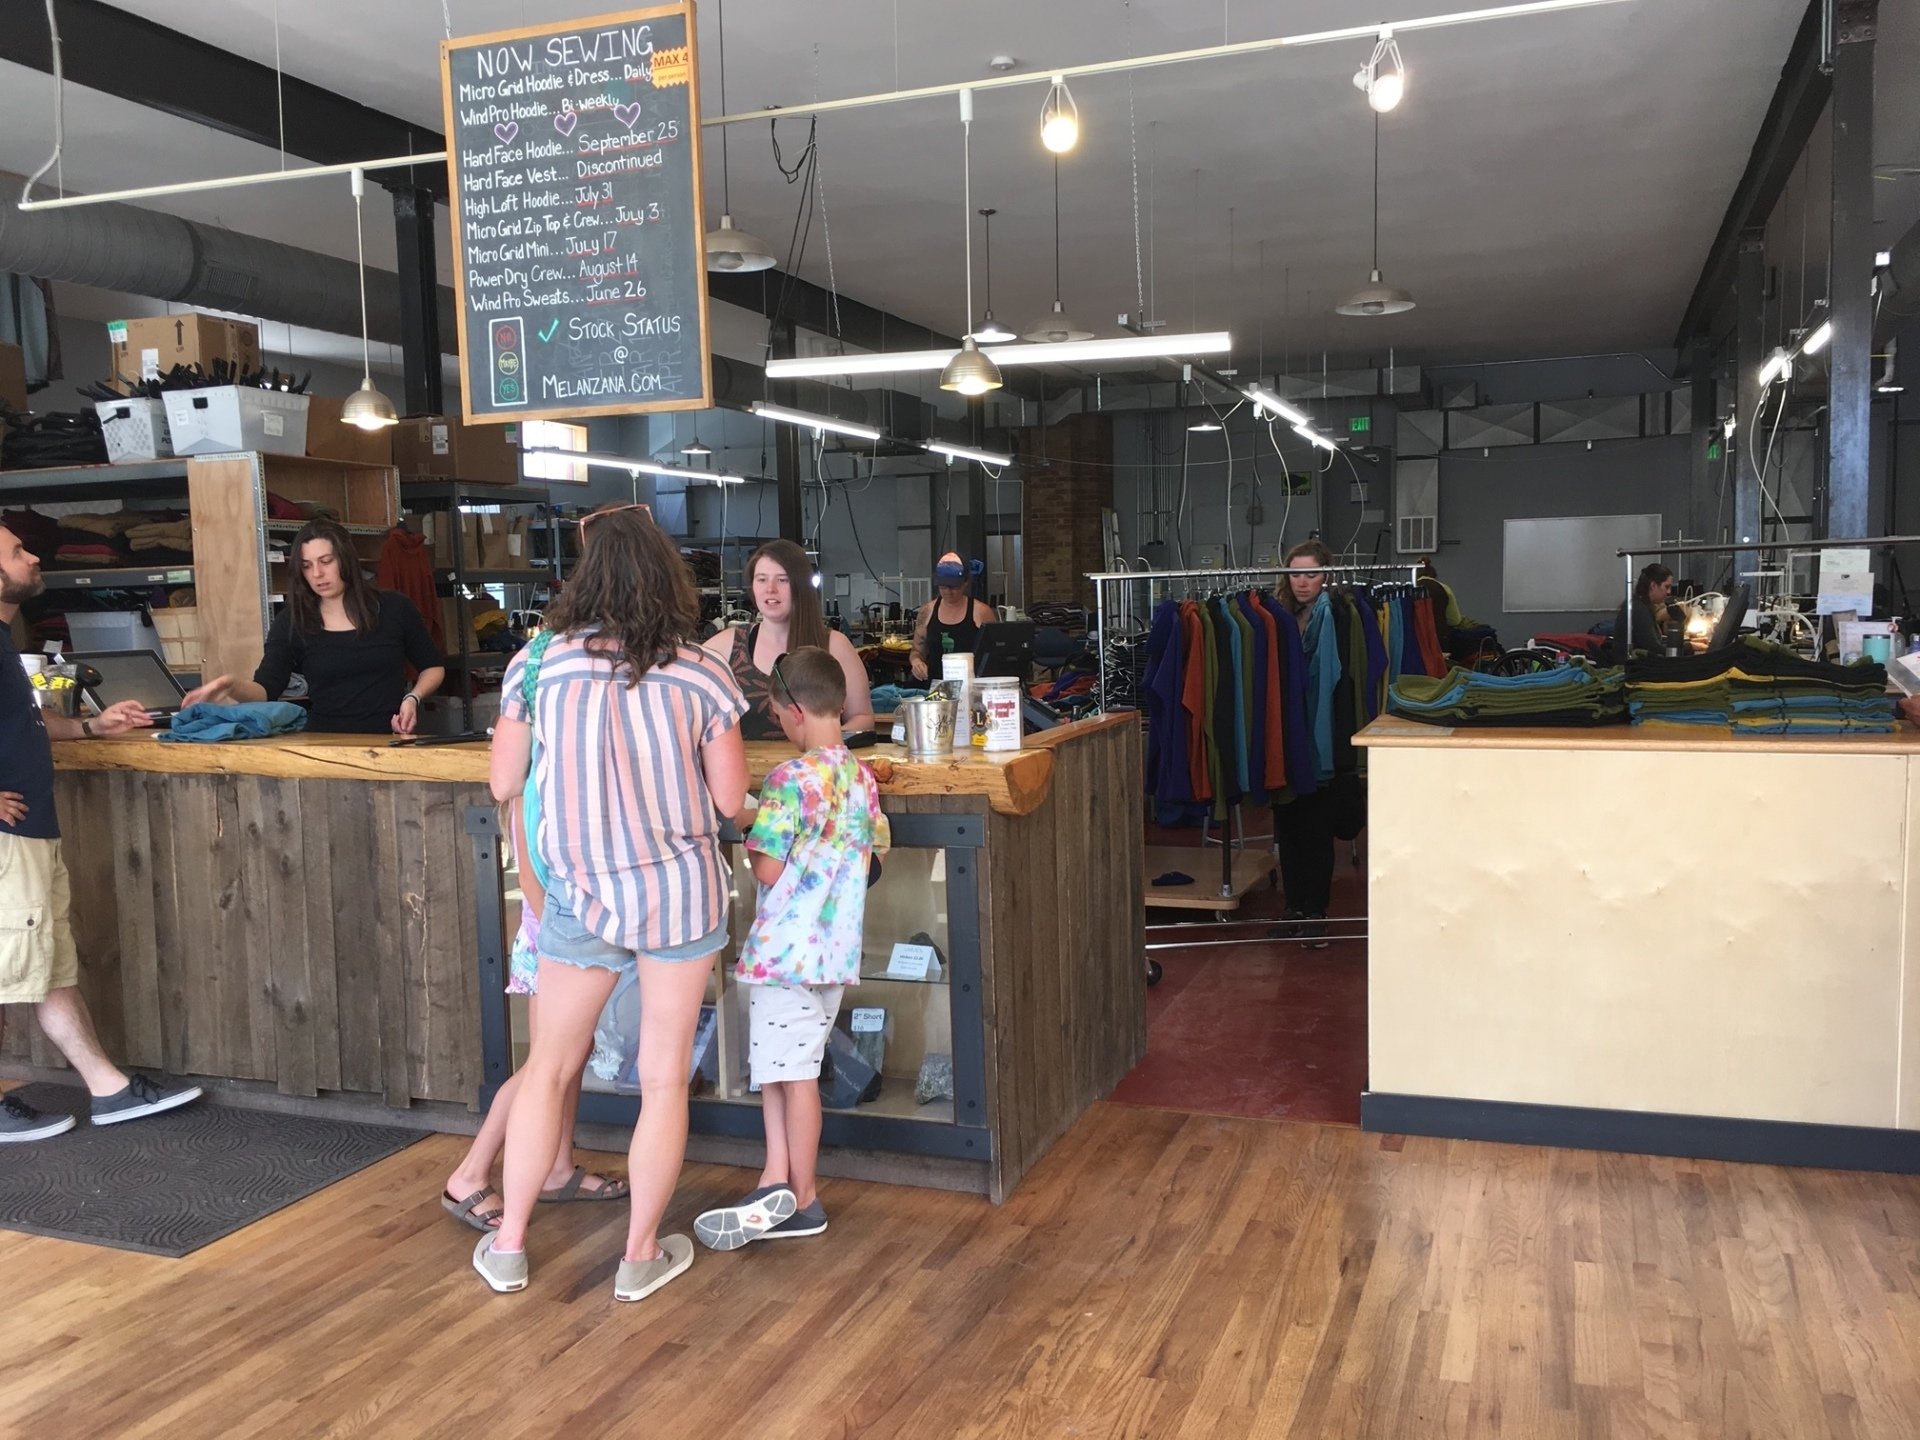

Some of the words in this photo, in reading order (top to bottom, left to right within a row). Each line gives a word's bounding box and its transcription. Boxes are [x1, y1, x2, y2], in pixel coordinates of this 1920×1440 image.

[477, 44, 533, 79] NOW
[544, 25, 653, 66] SEWING
[653, 53, 680, 68] MAX
[460, 84, 496, 102] Micro
[498, 78, 524, 96] Grid
[526, 74, 564, 92] Hoodie
[624, 62, 652, 82] Daily
[462, 147, 493, 168] Hard
[494, 144, 524, 164] Face
[578, 129, 655, 156] September
[657, 120, 678, 140] 25
[464, 172, 492, 192] Hard
[494, 170, 523, 188] Face
[576, 148, 663, 178] Discontinued
[464, 197, 490, 219] High
[491, 194, 518, 214] Loft
[574, 185, 599, 210] July
[601, 181, 613, 199] 31
[466, 221, 497, 240] Micro
[498, 219, 522, 237] Grid
[523, 216, 542, 236] Zip
[542, 214, 560, 235] Top
[615, 206, 644, 226] July
[648, 202, 660, 220] 3
[468, 246, 498, 264] Micro
[500, 243, 524, 261] Grid
[565, 236, 600, 256] July
[603, 230, 618, 249] 17
[469, 269, 504, 288] Power
[504, 268, 528, 290] Dry
[579, 256, 624, 285] August
[626, 252, 639, 273] 14
[470, 294, 502, 312] Wind
[503, 291, 520, 309] Pro
[586, 284, 620, 302] June
[624, 280, 647, 298] 26
[568, 316, 615, 341] STOCK
[622, 312, 682, 336] STATUS
[614, 345, 629, 364] @
[502, 382, 516, 395] YES
[542, 372, 663, 400] MELANZANA.COM
[1352, 417, 1370, 432] EXIT
[864, 1012, 882, 1020] Short
